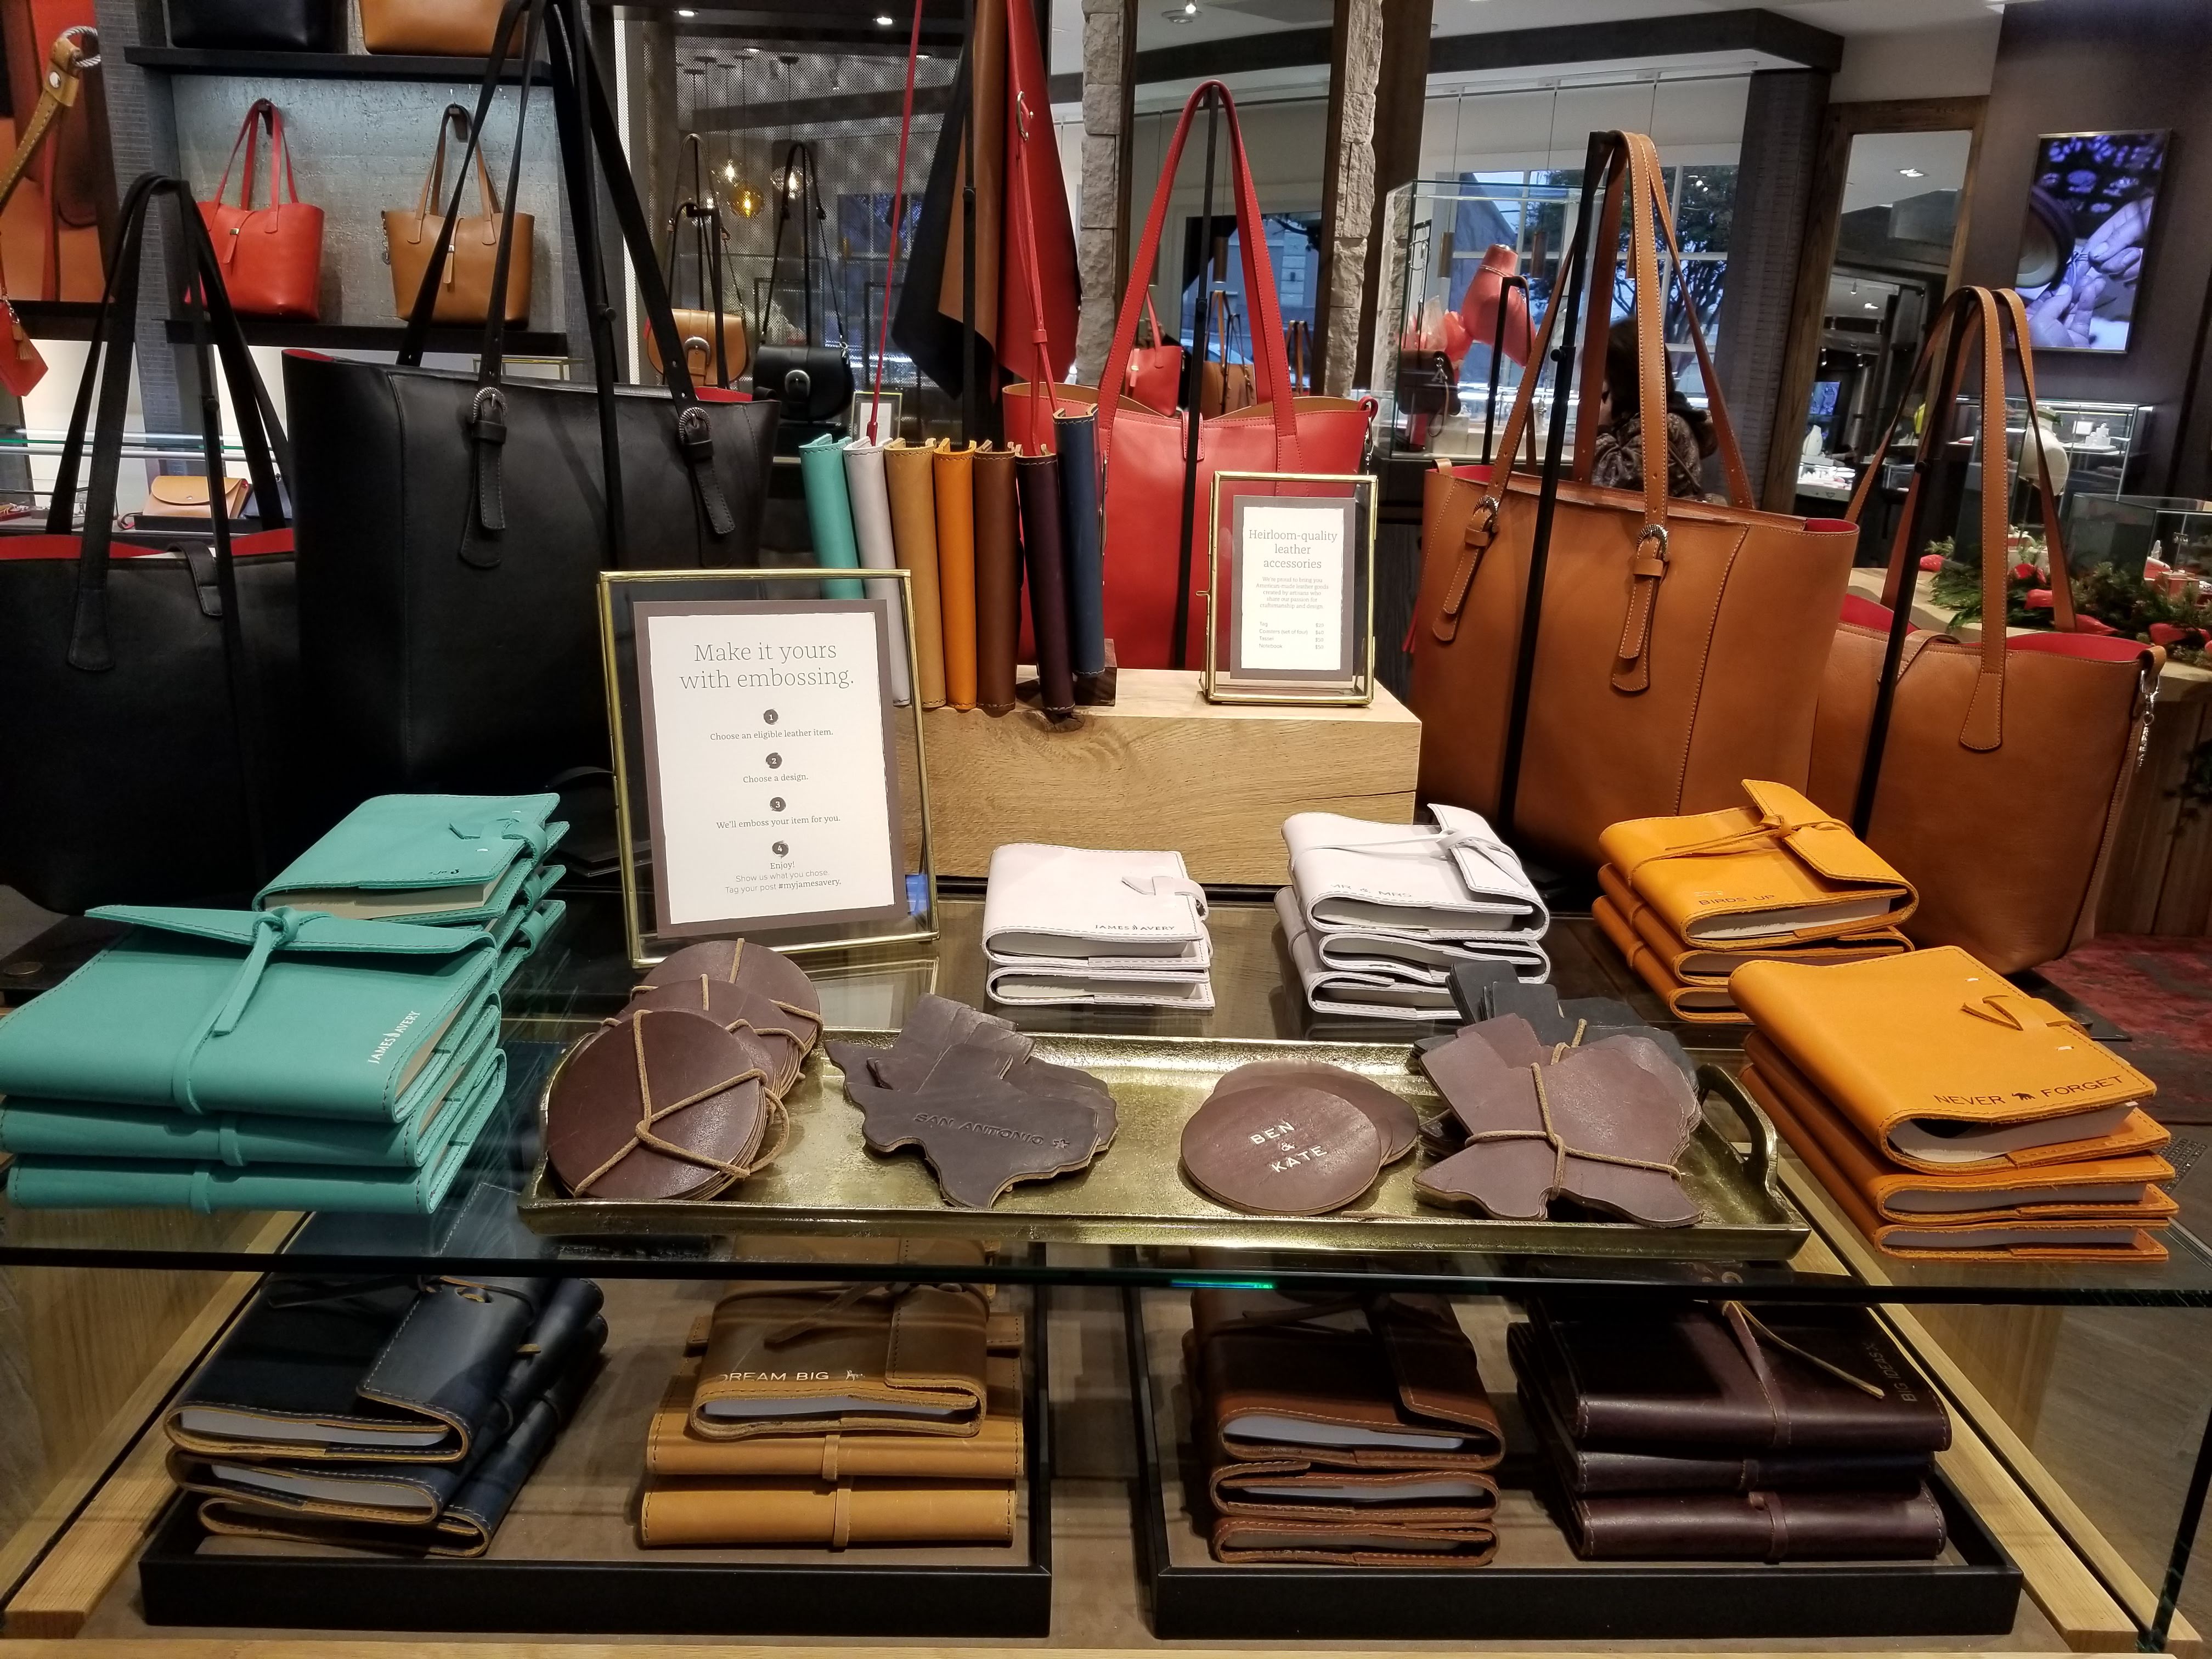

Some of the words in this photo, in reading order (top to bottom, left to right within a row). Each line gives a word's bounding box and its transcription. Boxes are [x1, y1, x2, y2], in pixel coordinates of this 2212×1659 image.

[1249, 529, 1338, 543] Heirloom-quality
[1275, 544, 1311, 554] leather
[1263, 559, 1322, 568] accessories
[694, 642, 751, 661] Make
[759, 642, 773, 660] it
[778, 645, 837, 664] yours
[679, 669, 731, 689] with
[737, 668, 854, 689] embossing.
[754, 730, 782, 740] eligible
[781, 774, 808, 782] design.
[716, 821, 737, 829] We'll
[738, 819, 769, 828] emboss
[771, 819, 789, 827] your
[823, 815, 840, 824] you.
[770, 861, 795, 870] Enjoy!
[725, 886, 738, 894] Tag
[741, 885, 757, 894] your
[760, 884, 776, 892] post
[778, 879, 842, 889] #myjamesavery.
[1699, 897, 1747, 905] BIRDS
[368, 1037, 396, 1064] JAMES
[395, 1011, 420, 1033] AVERY
[1933, 1094, 2006, 1105] NEVER
[2040, 1075, 2124, 1097] FORGET
[913, 1113, 954, 1128] SAN
[958, 1121, 1044, 1145] ANTONIO
[1250, 1122, 1295, 1145] BEN
[1280, 1142, 1295, 1152] &
[1271, 1146, 1328, 1173] KATE
[716, 1372, 787, 1383] DREAM
[796, 1372, 830, 1381] BIG
